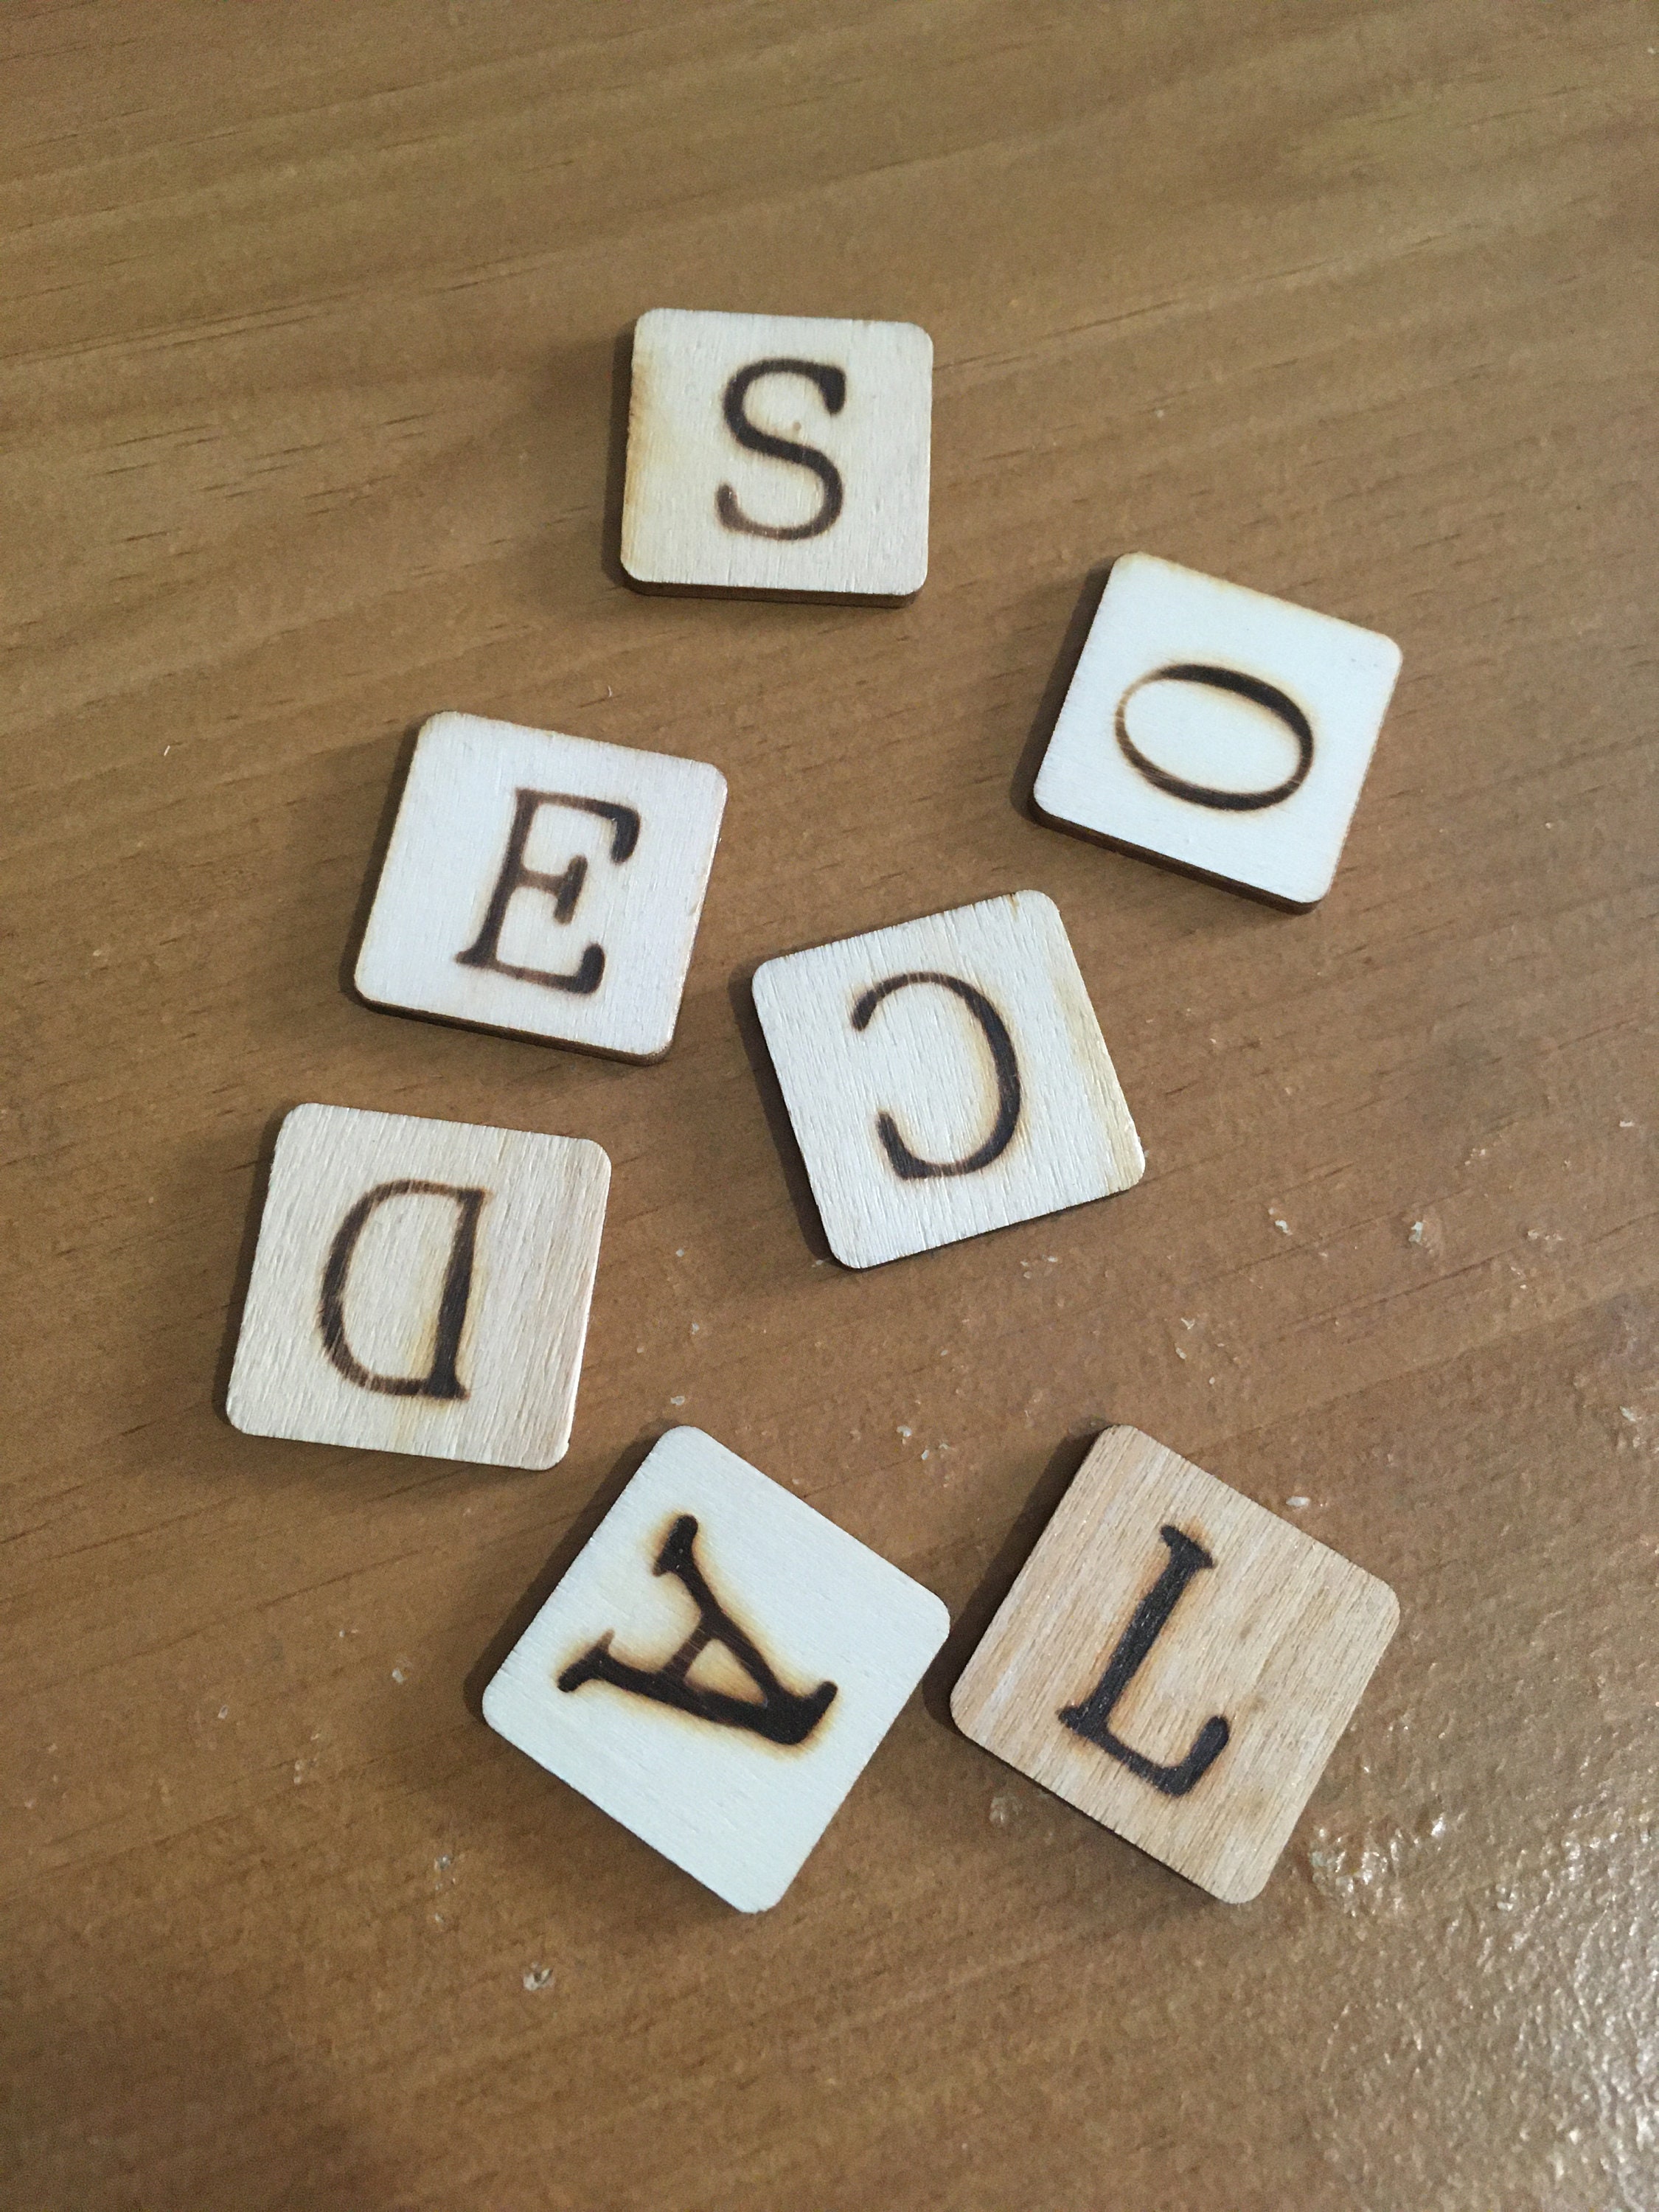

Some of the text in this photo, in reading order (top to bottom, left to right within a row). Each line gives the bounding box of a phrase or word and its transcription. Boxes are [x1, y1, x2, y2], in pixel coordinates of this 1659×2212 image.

[717, 358, 846, 540] S
[1116, 661, 1314, 813] O
[457, 789, 641, 994] E
[852, 971, 1021, 1180] C
[319, 1177, 490, 1401] D
[559, 1516, 838, 1747] A
[1058, 1523, 1231, 1799] L
